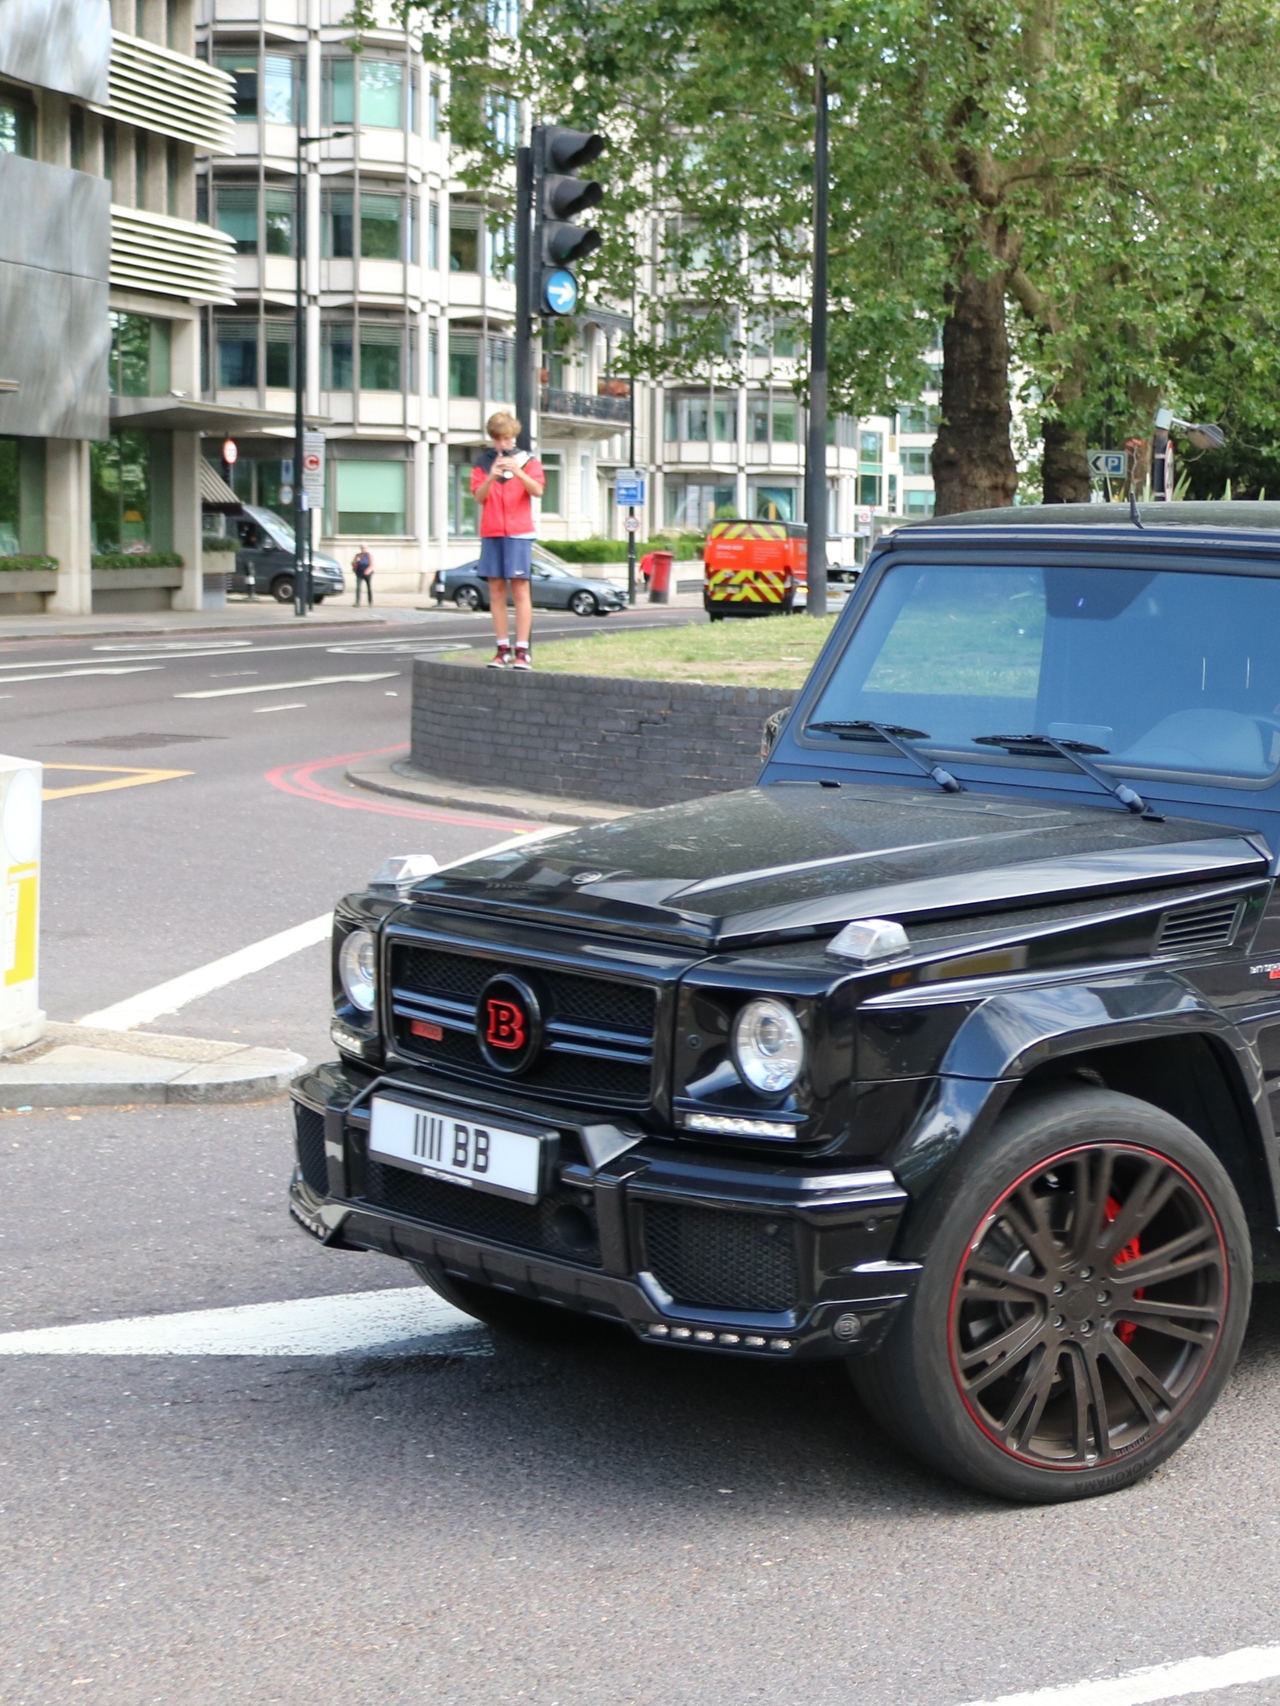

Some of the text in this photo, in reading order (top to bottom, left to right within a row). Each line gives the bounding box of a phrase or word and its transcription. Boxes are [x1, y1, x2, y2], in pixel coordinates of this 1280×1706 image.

[1107, 457, 1119, 471] P
[487, 999, 525, 1050] B
[452, 1123, 490, 1174] BB
[1074, 1459, 1150, 1491] YOKOHAMA
